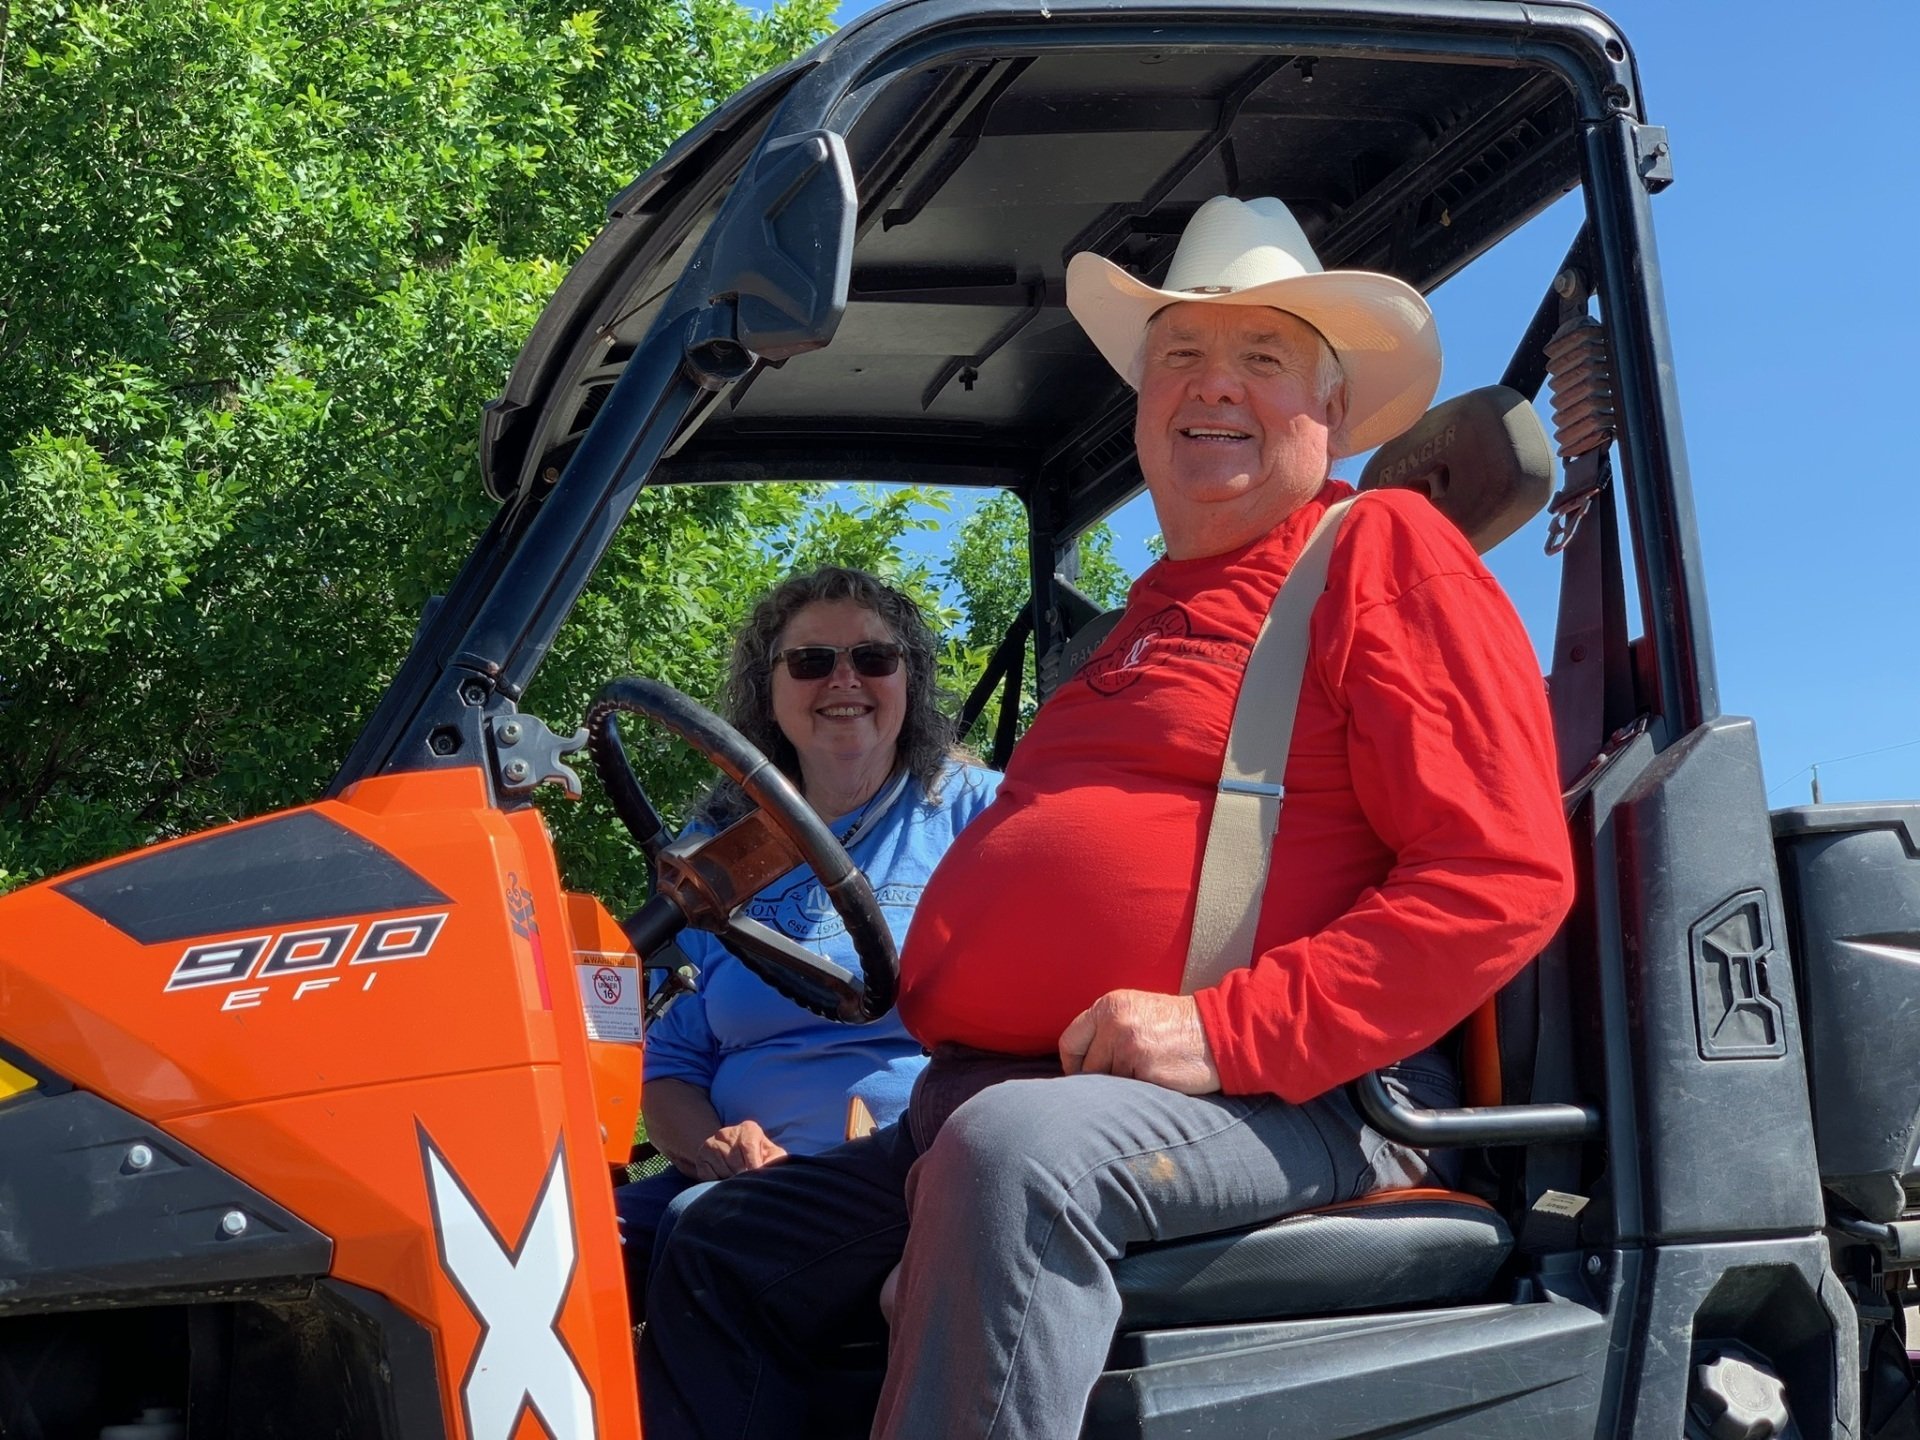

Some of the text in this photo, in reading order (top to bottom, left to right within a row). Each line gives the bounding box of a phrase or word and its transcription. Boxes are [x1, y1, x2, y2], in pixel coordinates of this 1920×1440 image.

[1377, 424, 1458, 487] RANGER
[874, 889, 919, 902] ANC
[787, 919, 809, 935] est.
[163, 912, 450, 992] 900
[220, 971, 378, 1012] EFI
[603, 989, 614, 999] 16
[412, 1112, 598, 1440] X
